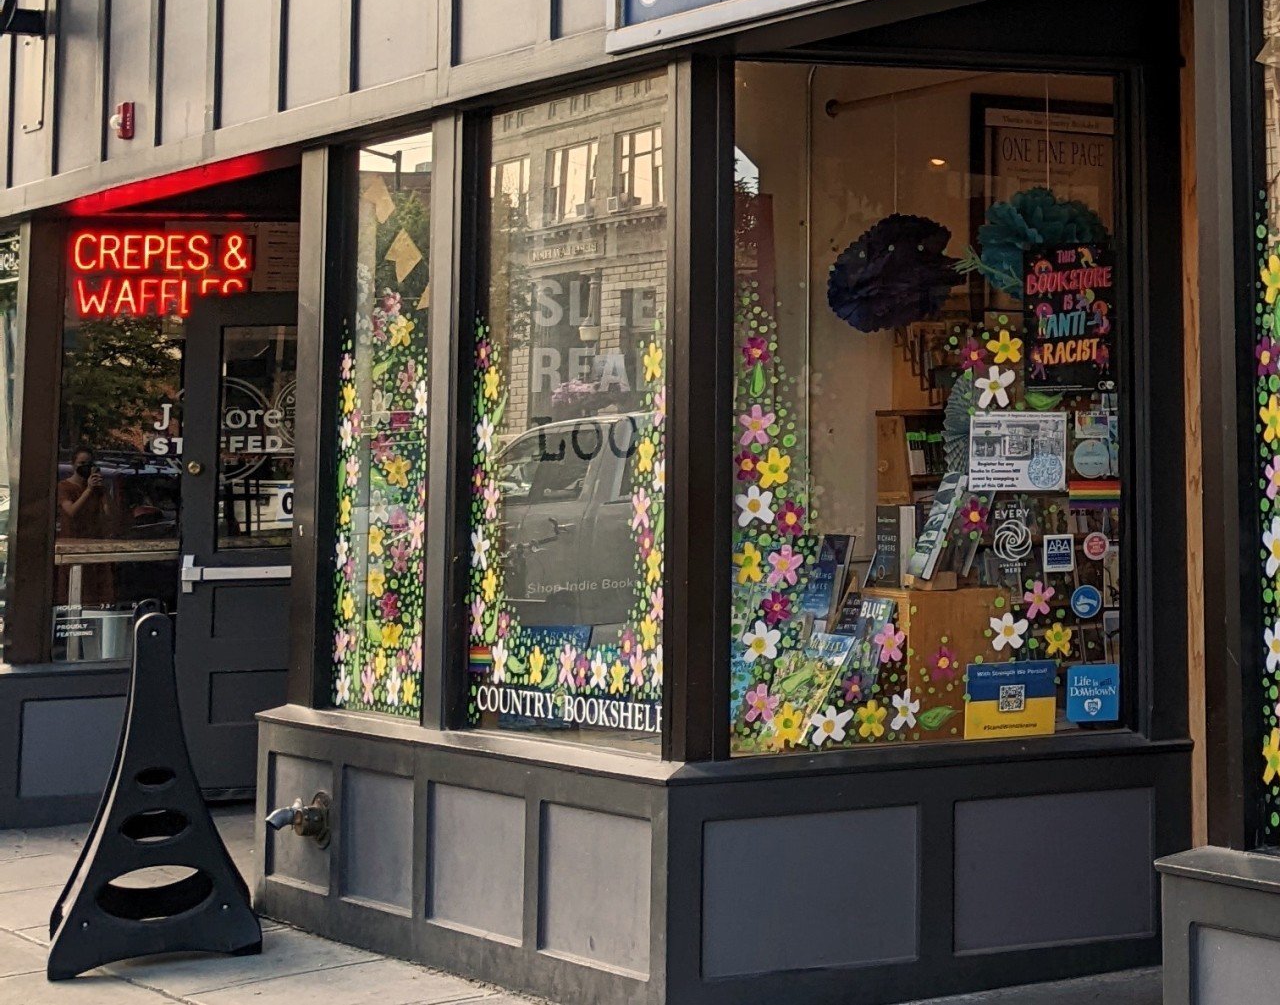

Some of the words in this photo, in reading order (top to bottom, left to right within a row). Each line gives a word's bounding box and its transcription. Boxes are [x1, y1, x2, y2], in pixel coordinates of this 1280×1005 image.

[1002, 136, 1032, 163] ONE
[1037, 139, 1066, 164] FINE
[1071, 142, 1105, 167] PAGE
[75, 234, 210, 271] CREPES
[224, 234, 248, 271] &
[1057, 249, 1076, 263] THIS
[1026, 266, 1113, 295] BOOKSTORE
[1063, 294, 1073, 311] IS
[1043, 338, 1100, 365] RACIST
[152, 436, 283, 455] STFED
[994, 508, 1030, 519] EVERY
[527, 583, 561, 596] Shop
[565, 580, 598, 592] Indie
[860, 600, 887, 621] BLUE
[56, 630, 93, 638] FEATURING
[1074, 676, 1092, 686] Life
[477, 685, 555, 720] COUNTRY
